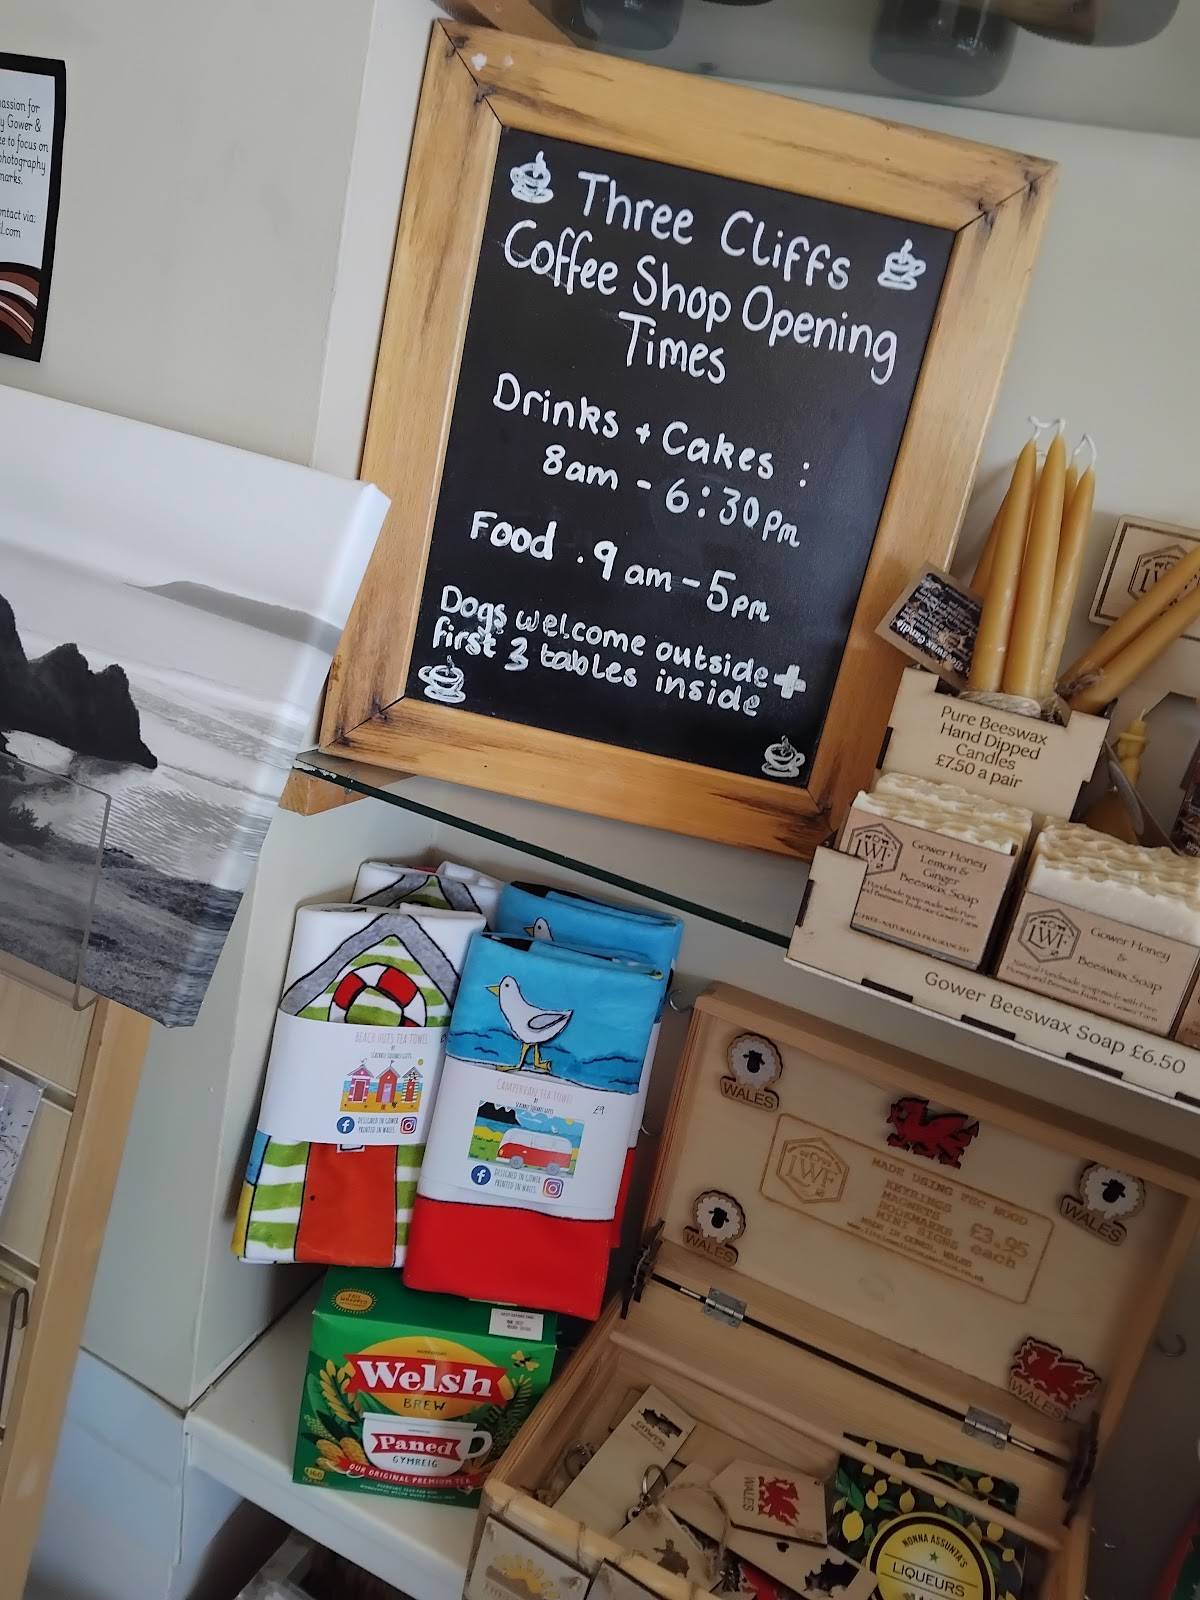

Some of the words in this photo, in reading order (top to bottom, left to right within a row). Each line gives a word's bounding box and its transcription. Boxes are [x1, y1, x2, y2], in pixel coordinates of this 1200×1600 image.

[8, 113, 33, 131] Gower
[34, 118, 41, 132] &
[27, 98, 41, 118] for
[8, 136, 15, 147] to
[16, 134, 37, 153] focus
[38, 143, 49, 153] on
[0, 208, 21, 220] ntact
[578, 171, 693, 245] Three
[720, 210, 851, 290] Cliffs
[504, 220, 618, 295] Coffee
[633, 255, 731, 332] Shop
[742, 285, 898, 385] Opening
[618, 312, 727, 384] Times
[493, 373, 619, 438] Drinks
[662, 421, 774, 480] Cakes
[543, 444, 618, 492] 8am
[665, 479, 800, 548] 6:30pm
[470, 510, 557, 560] Food
[440, 585, 508, 635] Dogs
[515, 607, 646, 657] welcome
[655, 641, 769, 688] outside
[432, 616, 497, 659] first
[503, 636, 529, 671] 3
[539, 642, 638, 688] tables
[655, 668, 761, 717] inside
[940, 723, 981, 745] Hand
[983, 734, 1041, 760] Dipped
[941, 705, 977, 726] Pure
[980, 715, 1049, 746] Beeswax
[935, 753, 975, 776] £7.50
[978, 769, 987, 780] a
[990, 771, 1024, 790] pair
[956, 743, 1016, 770] Candles
[911, 839, 947, 857] Gower
[949, 849, 988, 873] Honey
[920, 854, 956, 873] Lemon
[899, 871, 948, 895] Beeswax
[948, 888, 980, 910] Soap
[922, 868, 960, 888] Ginger
[1090, 927, 1129, 945] Gower
[1130, 937, 1171, 962] Honey
[1077, 955, 1128, 981] Beeswax
[1131, 973, 1162, 995] Soap
[397, 1033, 407, 1044] TEA
[409, 1033, 429, 1045] TOWEL
[924, 970, 986, 1003] Gower
[990, 993, 1072, 1035] Beeswax
[1076, 1024, 1125, 1056] Soap
[1129, 1044, 1186, 1075] £6.50
[722, 1079, 775, 1110] WALES
[872, 1157, 905, 1177] MADE
[912, 1173, 953, 1196] USING
[993, 1205, 1028, 1226] WOOD
[881, 1190, 941, 1221] MAGNETS
[885, 1180, 952, 1214] KEYRINGS
[876, 1209, 909, 1230] MINI
[916, 1227, 959, 1251] SIGNS
[878, 1200, 953, 1237] BOOKMARKS
[1063, 1201, 1122, 1243] WALES
[686, 1230, 734, 1262] WALES
[969, 1222, 1030, 1259] £3.95
[969, 1243, 1017, 1270] each
[357, 1360, 492, 1397] Welsh
[403, 1397, 446, 1411] BREW
[1009, 1380, 1064, 1421] WALES
[380, 1436, 455, 1457] Paned
[392, 1455, 439, 1469] GYMREIG
[349, 1463, 367, 1476] OUR
[368, 1467, 411, 1484] ORIGINAL
[411, 1475, 454, 1486] PREMIUM
[743, 1476, 756, 1513] WALES
[901, 1534, 929, 1548] NONNA
[931, 1534, 968, 1569] ASSUNTA'S
[892, 1561, 965, 1598] LIQUEURS
